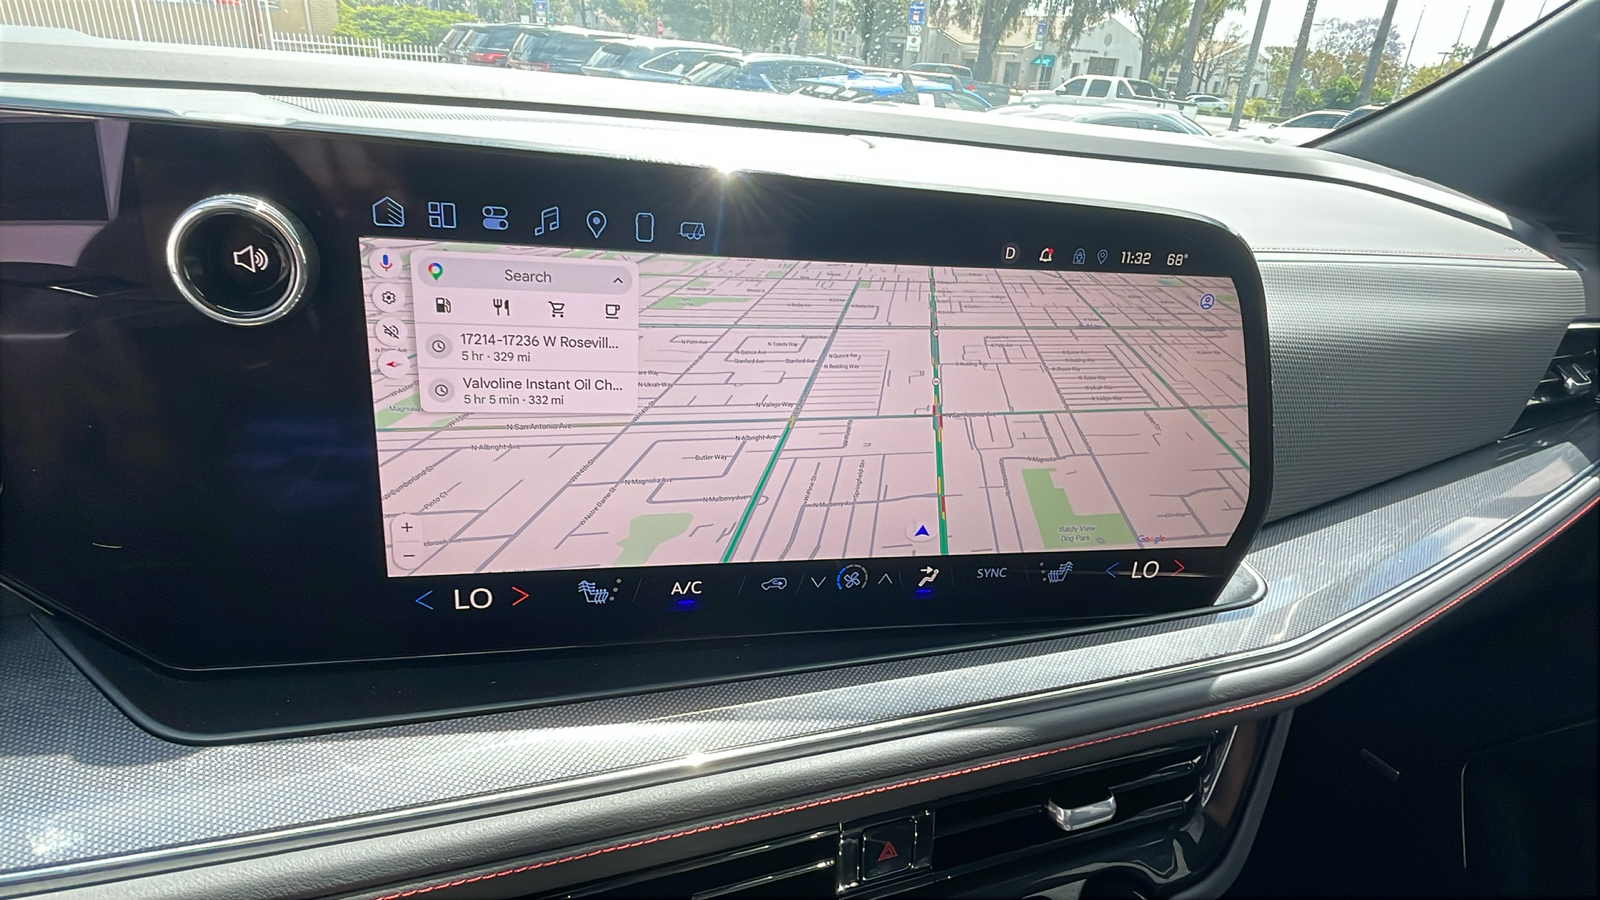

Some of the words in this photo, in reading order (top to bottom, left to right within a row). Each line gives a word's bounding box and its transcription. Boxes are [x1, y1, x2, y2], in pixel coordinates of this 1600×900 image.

[1005, 247, 1016, 260] D
[1120, 251, 1152, 265] 11:32
[1166, 253, 1188, 266] 68°
[504, 269, 552, 284] Search
[460, 333, 539, 347] 17214-17236
[542, 336, 558, 347] W
[461, 351, 468, 361] 5
[472, 351, 484, 361] hr
[493, 352, 514, 362] 329
[517, 352, 530, 362] mi
[463, 378, 522, 390] Valvoline
[526, 378, 570, 390] Instant
[574, 379, 590, 390] Oil
[464, 394, 470, 404] 5
[474, 394, 486, 404] hr
[489, 395, 496, 404] 5
[498, 395, 520, 405] min
[528, 396, 548, 405] 332
[551, 396, 564, 405] mi
[576, 464, 589, 476] 14th
[390, 469, 426, 496] Cumberland
[806, 482, 816, 495] Pine
[854, 468, 865, 498] Springfield
[424, 496, 440, 510] Pinto
[584, 505, 599, 521] Notre
[596, 492, 612, 508] Dame
[1059, 526, 1078, 534] Baldy
[1060, 535, 1075, 544] Dog
[1138, 535, 1166, 544] Google
[976, 567, 1008, 578] SYNC
[1131, 560, 1160, 579] LO
[671, 580, 702, 595] A/C
[454, 588, 493, 610] LO
